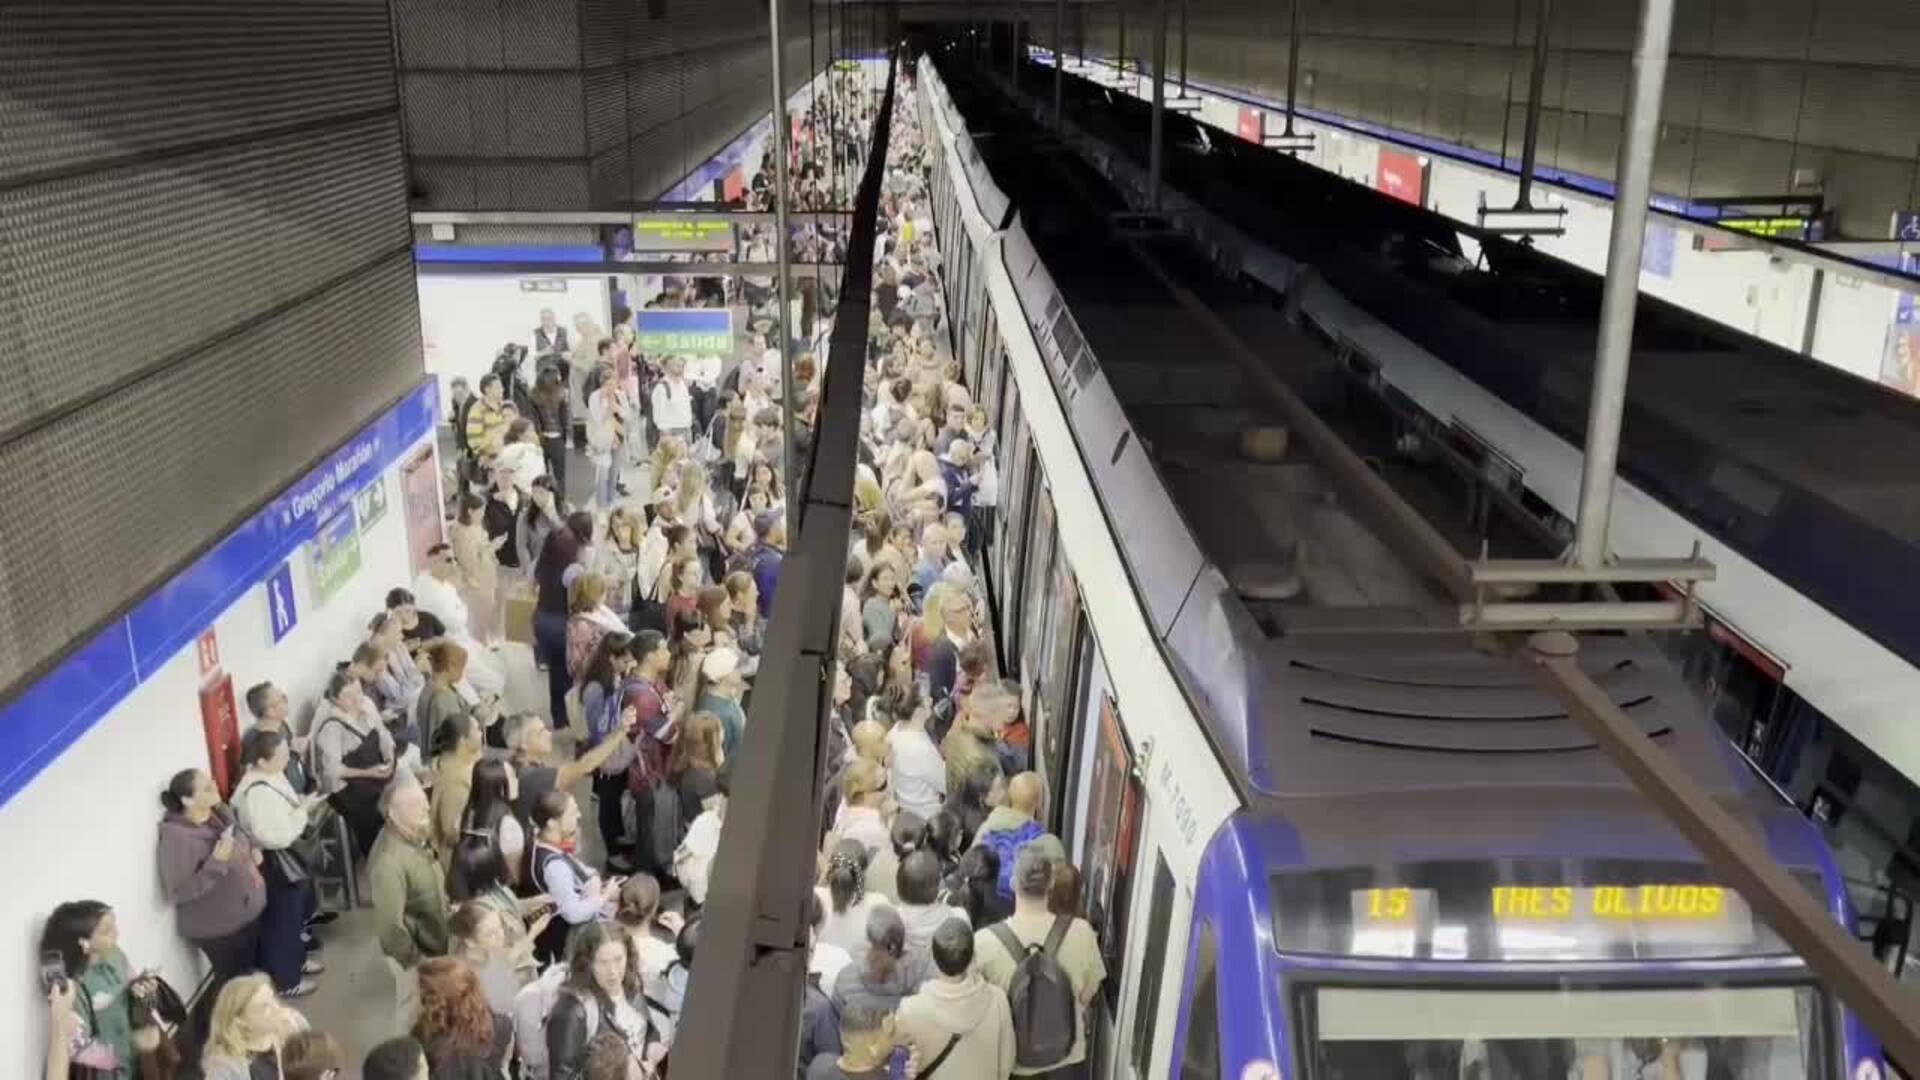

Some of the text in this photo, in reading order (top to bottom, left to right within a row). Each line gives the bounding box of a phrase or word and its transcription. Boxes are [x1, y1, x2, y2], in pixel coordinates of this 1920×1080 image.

[291, 473, 336, 519] Gregorio
[1369, 885, 1723, 918] 15 TRES OLIVOS
